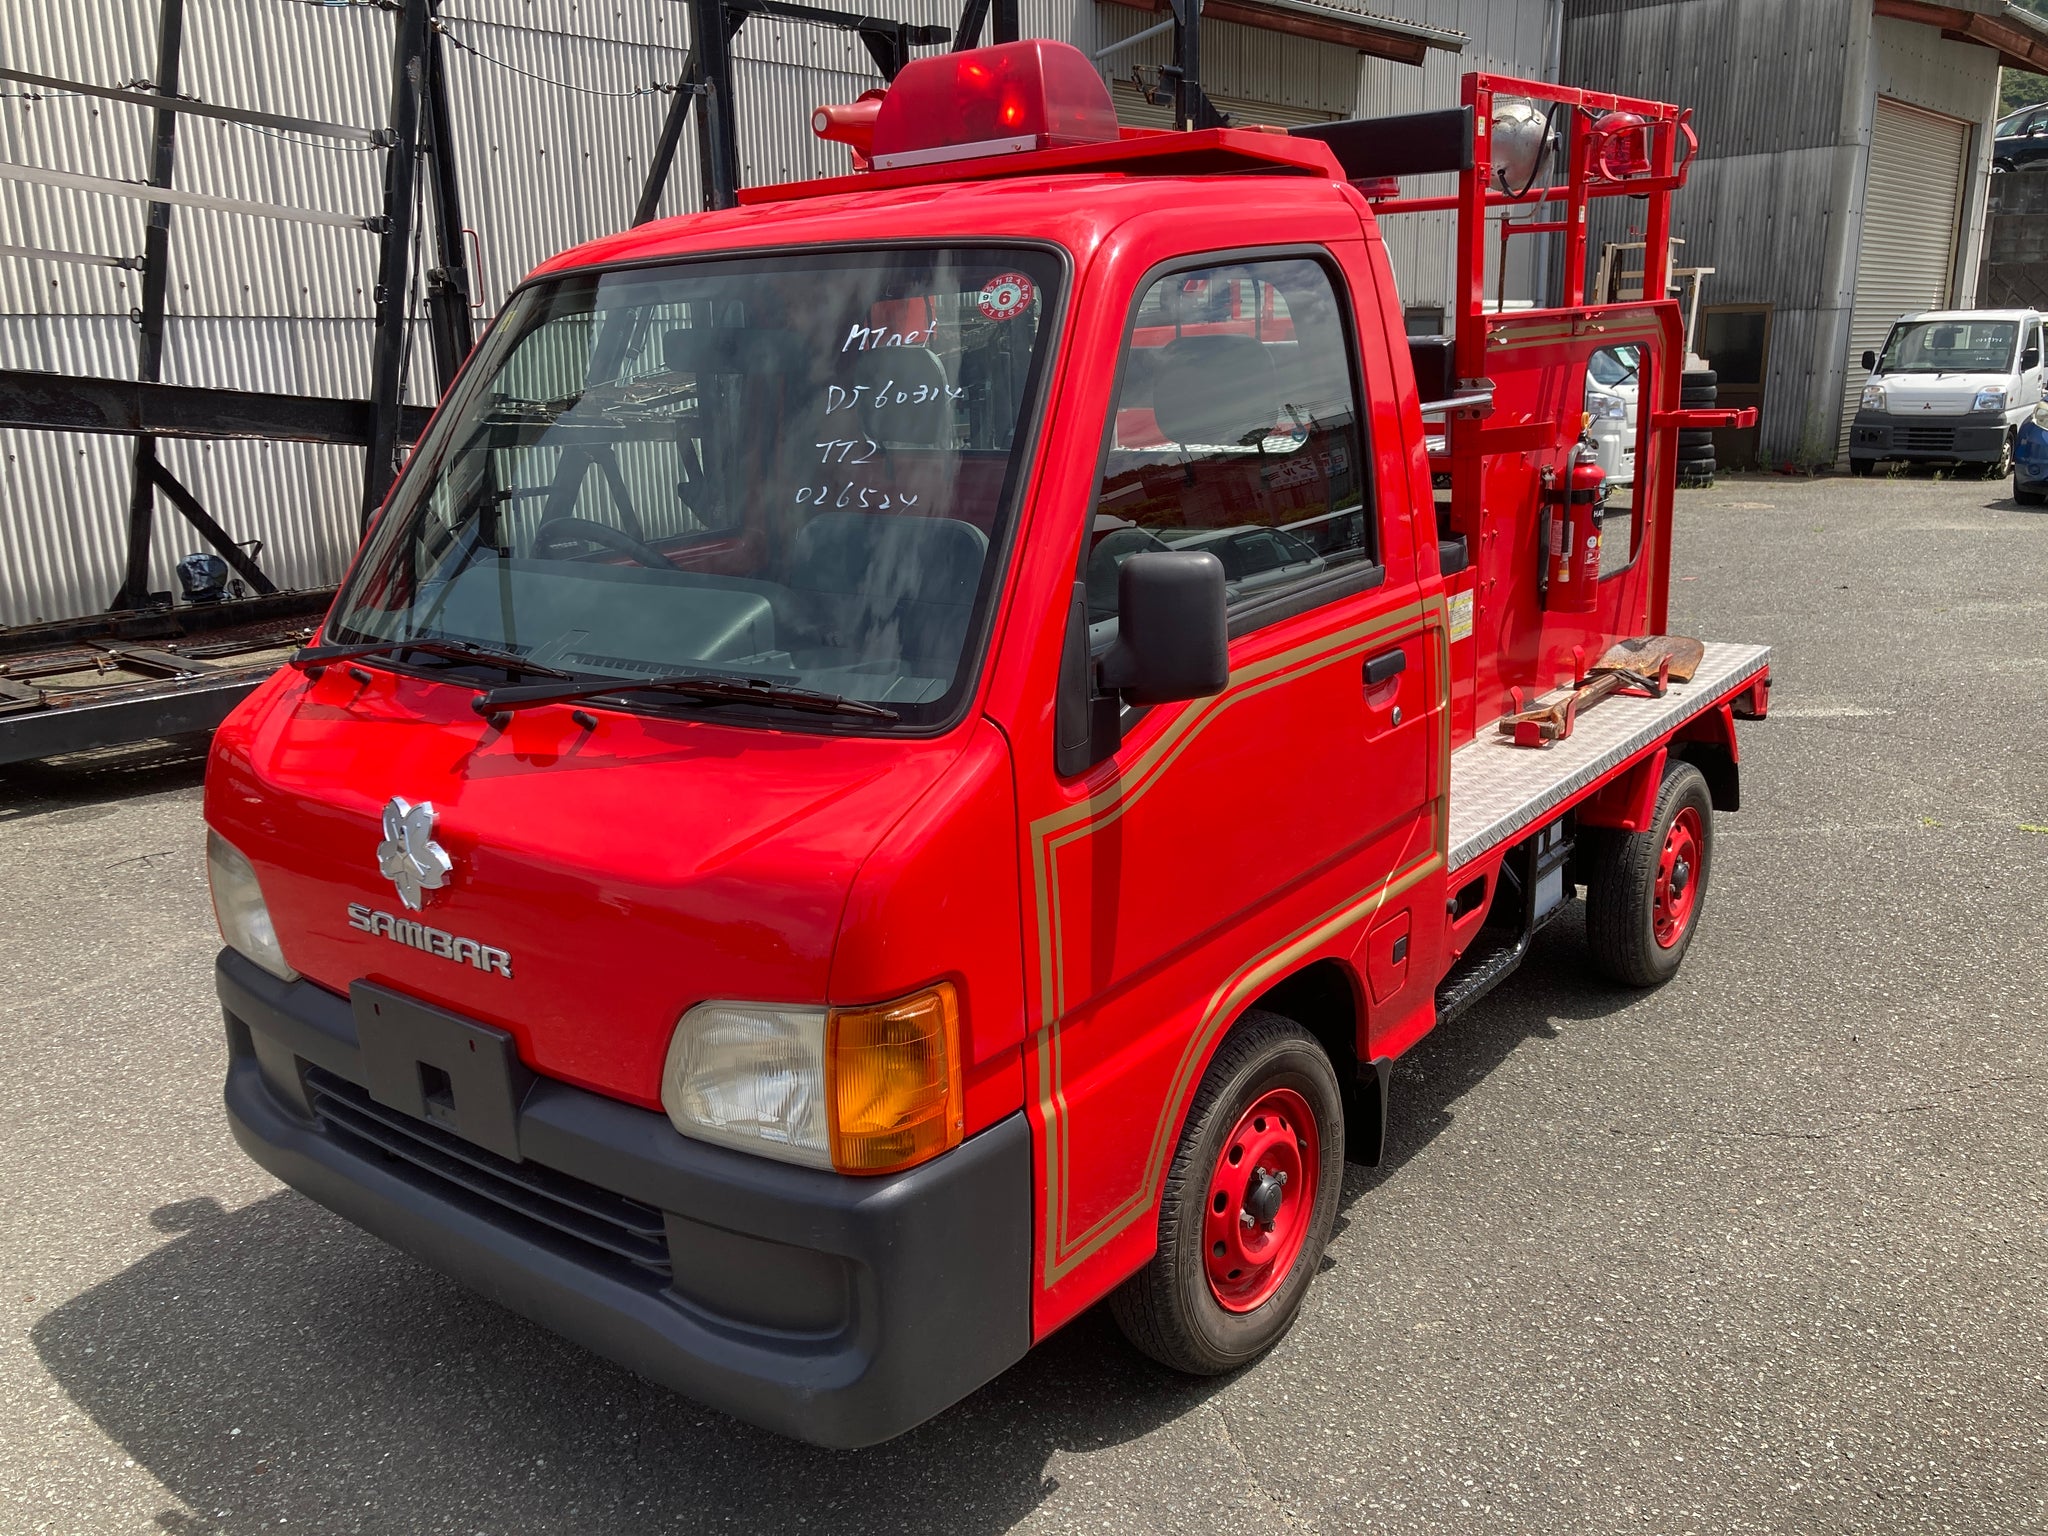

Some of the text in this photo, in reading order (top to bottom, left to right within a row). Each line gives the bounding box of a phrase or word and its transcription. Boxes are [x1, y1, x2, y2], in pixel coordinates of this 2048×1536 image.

[999, 291, 1011, 305] 6
[816, 439, 878, 465] TT2
[348, 902, 513, 978] SAMBAR
